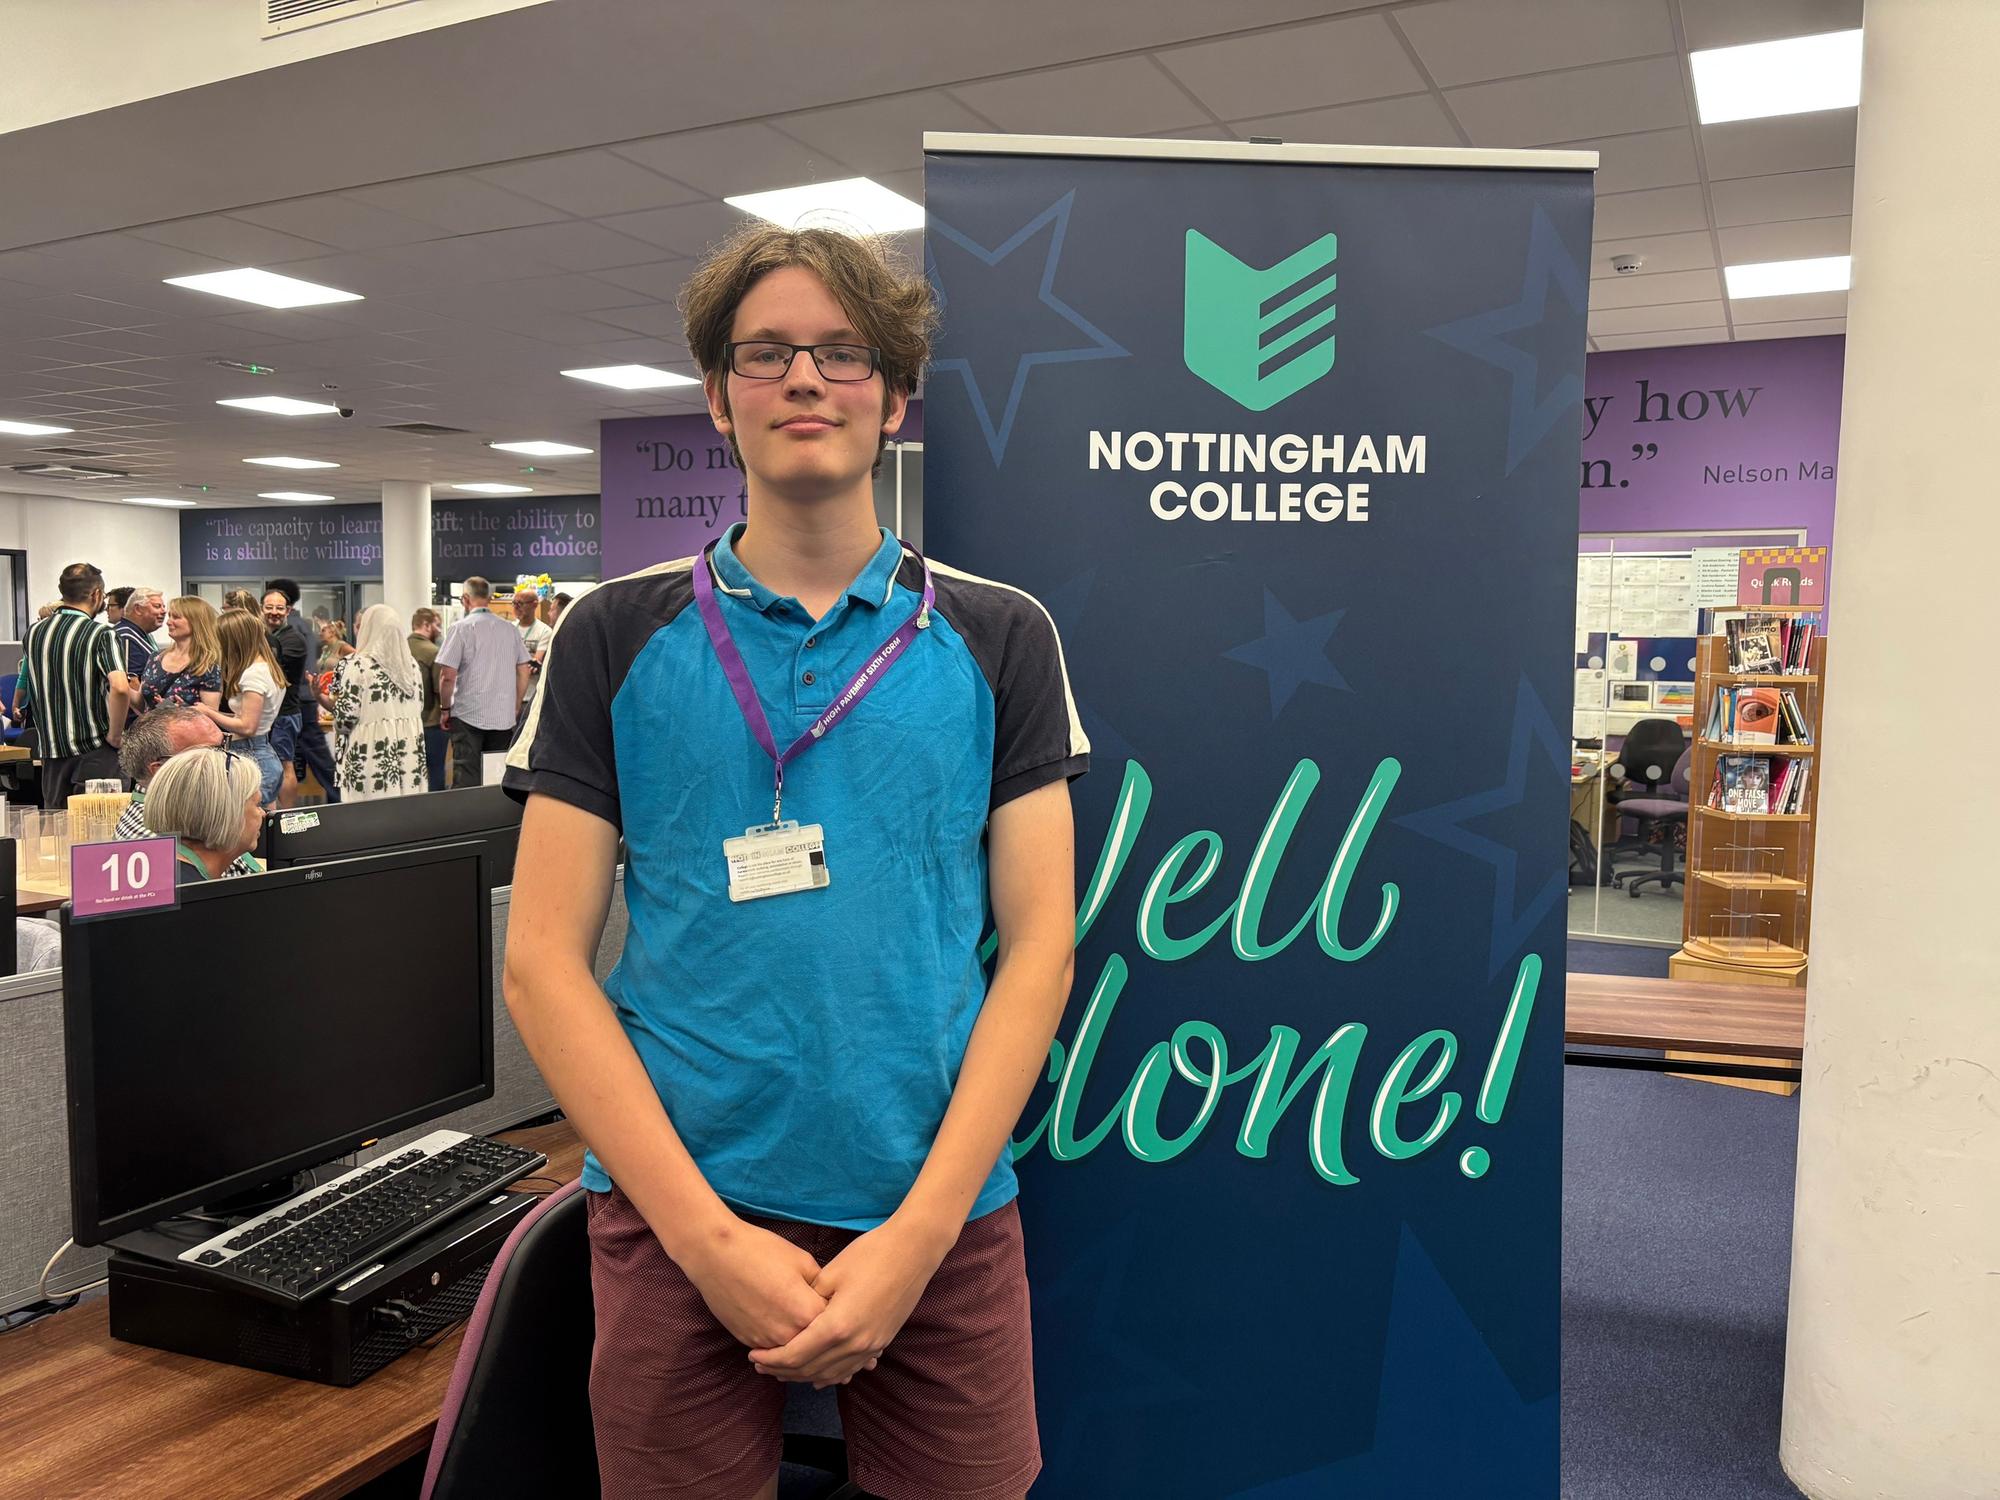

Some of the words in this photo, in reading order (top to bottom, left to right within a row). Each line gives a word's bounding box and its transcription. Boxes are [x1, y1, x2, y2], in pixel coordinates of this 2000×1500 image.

[1633, 379, 1763, 423] how
[636, 440, 694, 472] “Do
[1088, 430, 1426, 474] NOTTINGHAM
[1703, 464, 1788, 485] Nelson
[635, 495, 726, 528] many
[1149, 480, 1369, 522] COLLEGE
[248, 516, 314, 541] capacity
[319, 519, 335, 535] to
[341, 515, 383, 534] learn
[470, 510, 500, 531] the
[506, 509, 568, 536] ability
[575, 508, 595, 529] to
[206, 542, 219, 561] is
[223, 547, 232, 560] a
[236, 540, 278, 563] skill;
[283, 541, 309, 561] the
[438, 538, 484, 558] learn
[491, 537, 506, 557] is
[512, 544, 524, 557] a
[1751, 578, 1780, 589] Quk
[823, 704, 841, 726] HIGH
[839, 672, 869, 708] PAVEMENT
[866, 655, 885, 676] SIXTH
[881, 636, 901, 658] FORM
[1728, 788, 1744, 798] ONE
[1745, 789, 1766, 800] FALSE
[1738, 798, 1757, 808] MOVE
[101, 851, 150, 892] 10
